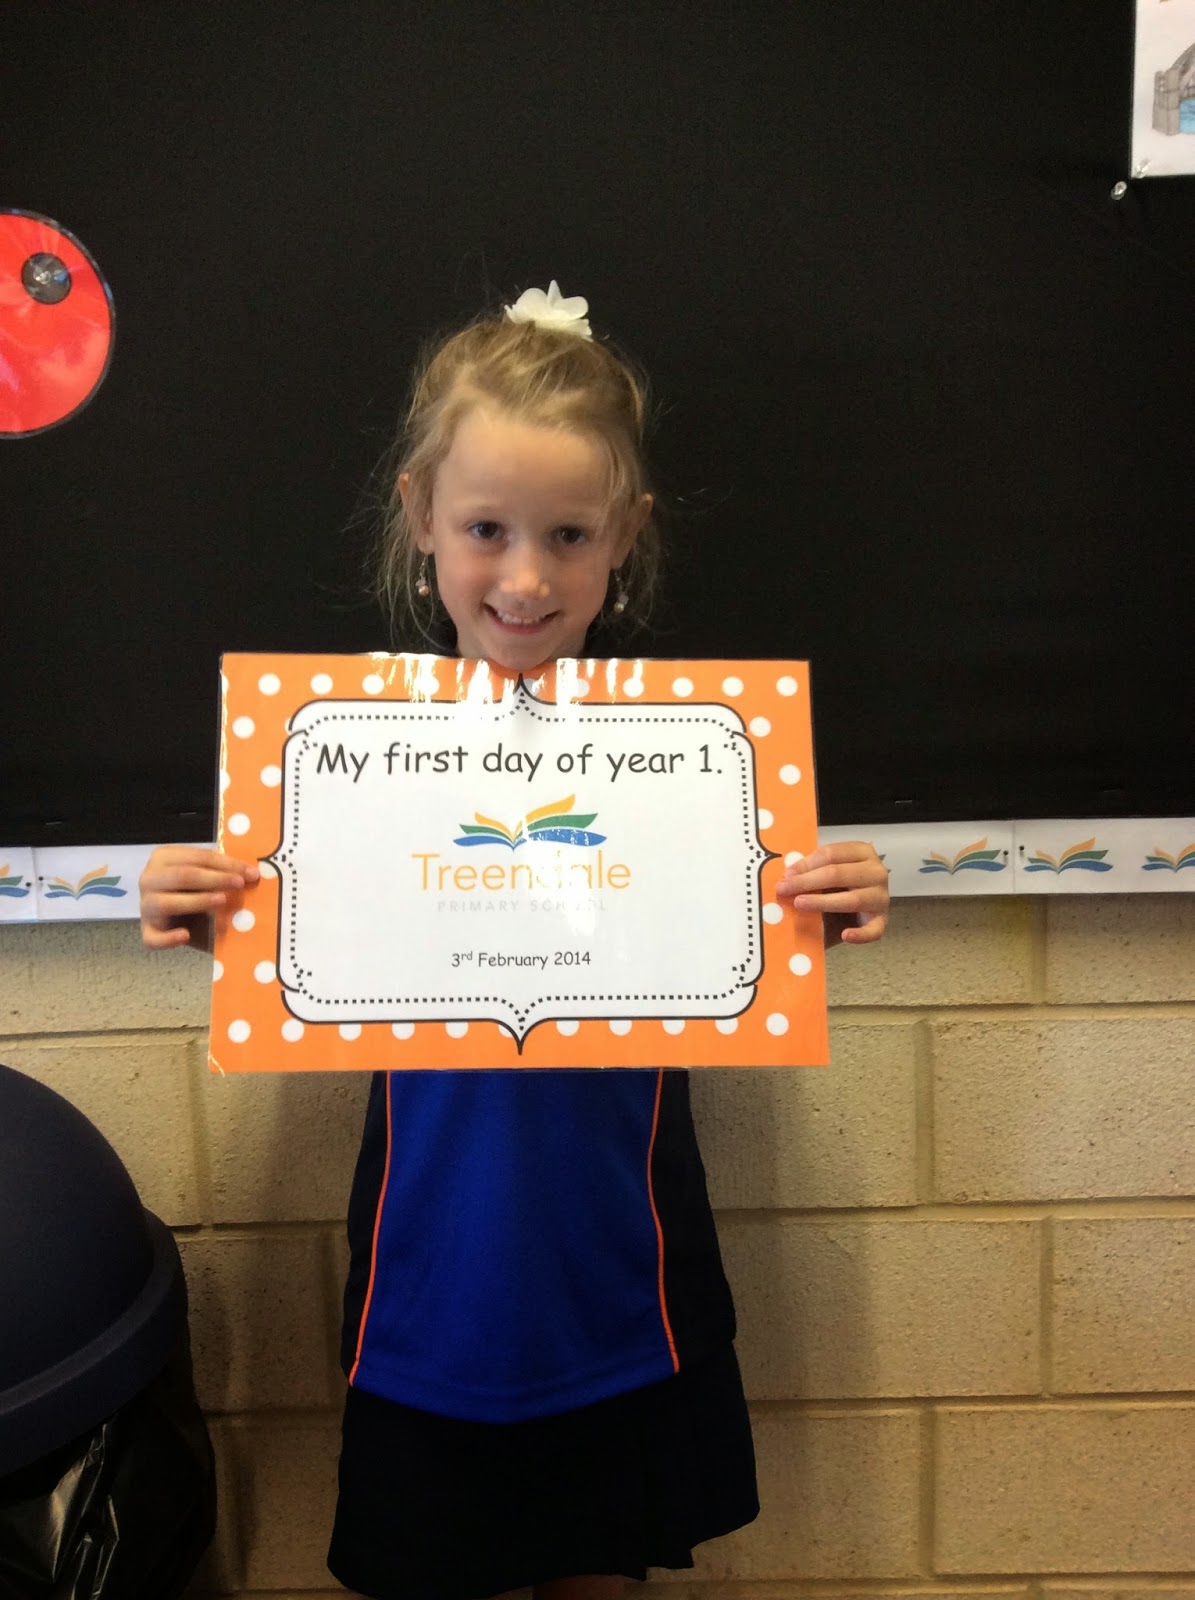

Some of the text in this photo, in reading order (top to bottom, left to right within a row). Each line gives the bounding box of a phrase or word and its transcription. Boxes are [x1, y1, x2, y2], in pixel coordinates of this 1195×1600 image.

[316, 742, 723, 783] My first day of year 1.
[411, 850, 631, 891] Treenle
[437, 899, 608, 912] PRIMARY SCHL
[451, 951, 591, 971] 3rd February 2014
